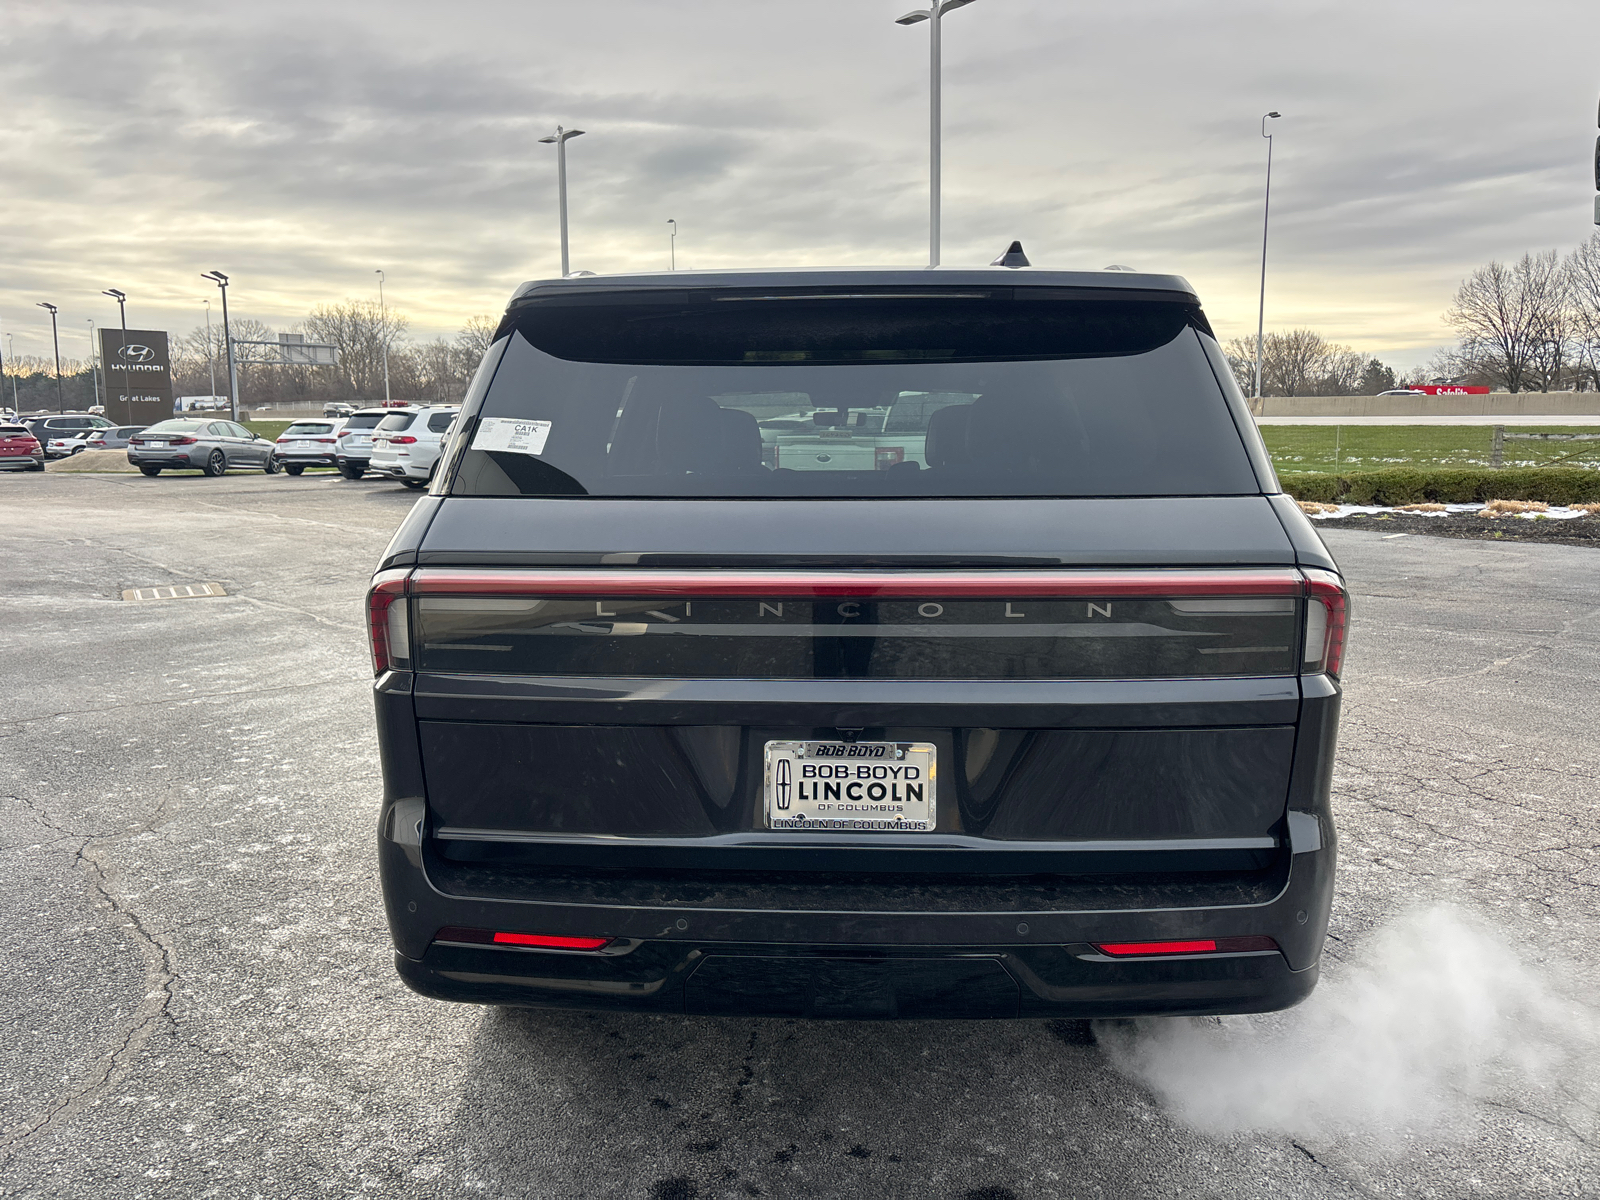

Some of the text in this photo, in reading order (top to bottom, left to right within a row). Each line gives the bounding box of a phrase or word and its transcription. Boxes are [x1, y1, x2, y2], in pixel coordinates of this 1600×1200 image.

[111, 364, 164, 372] HYUNDAI
[514, 424, 539, 433] CA1K
[596, 601, 1112, 618] LINCOLN
[802, 764, 920, 780] BOB-BOYD
[798, 781, 924, 802] LINCOLN
[837, 804, 904, 812] COLUMBUS
[773, 820, 927, 830] LINCOLN OF COLUMBUS
